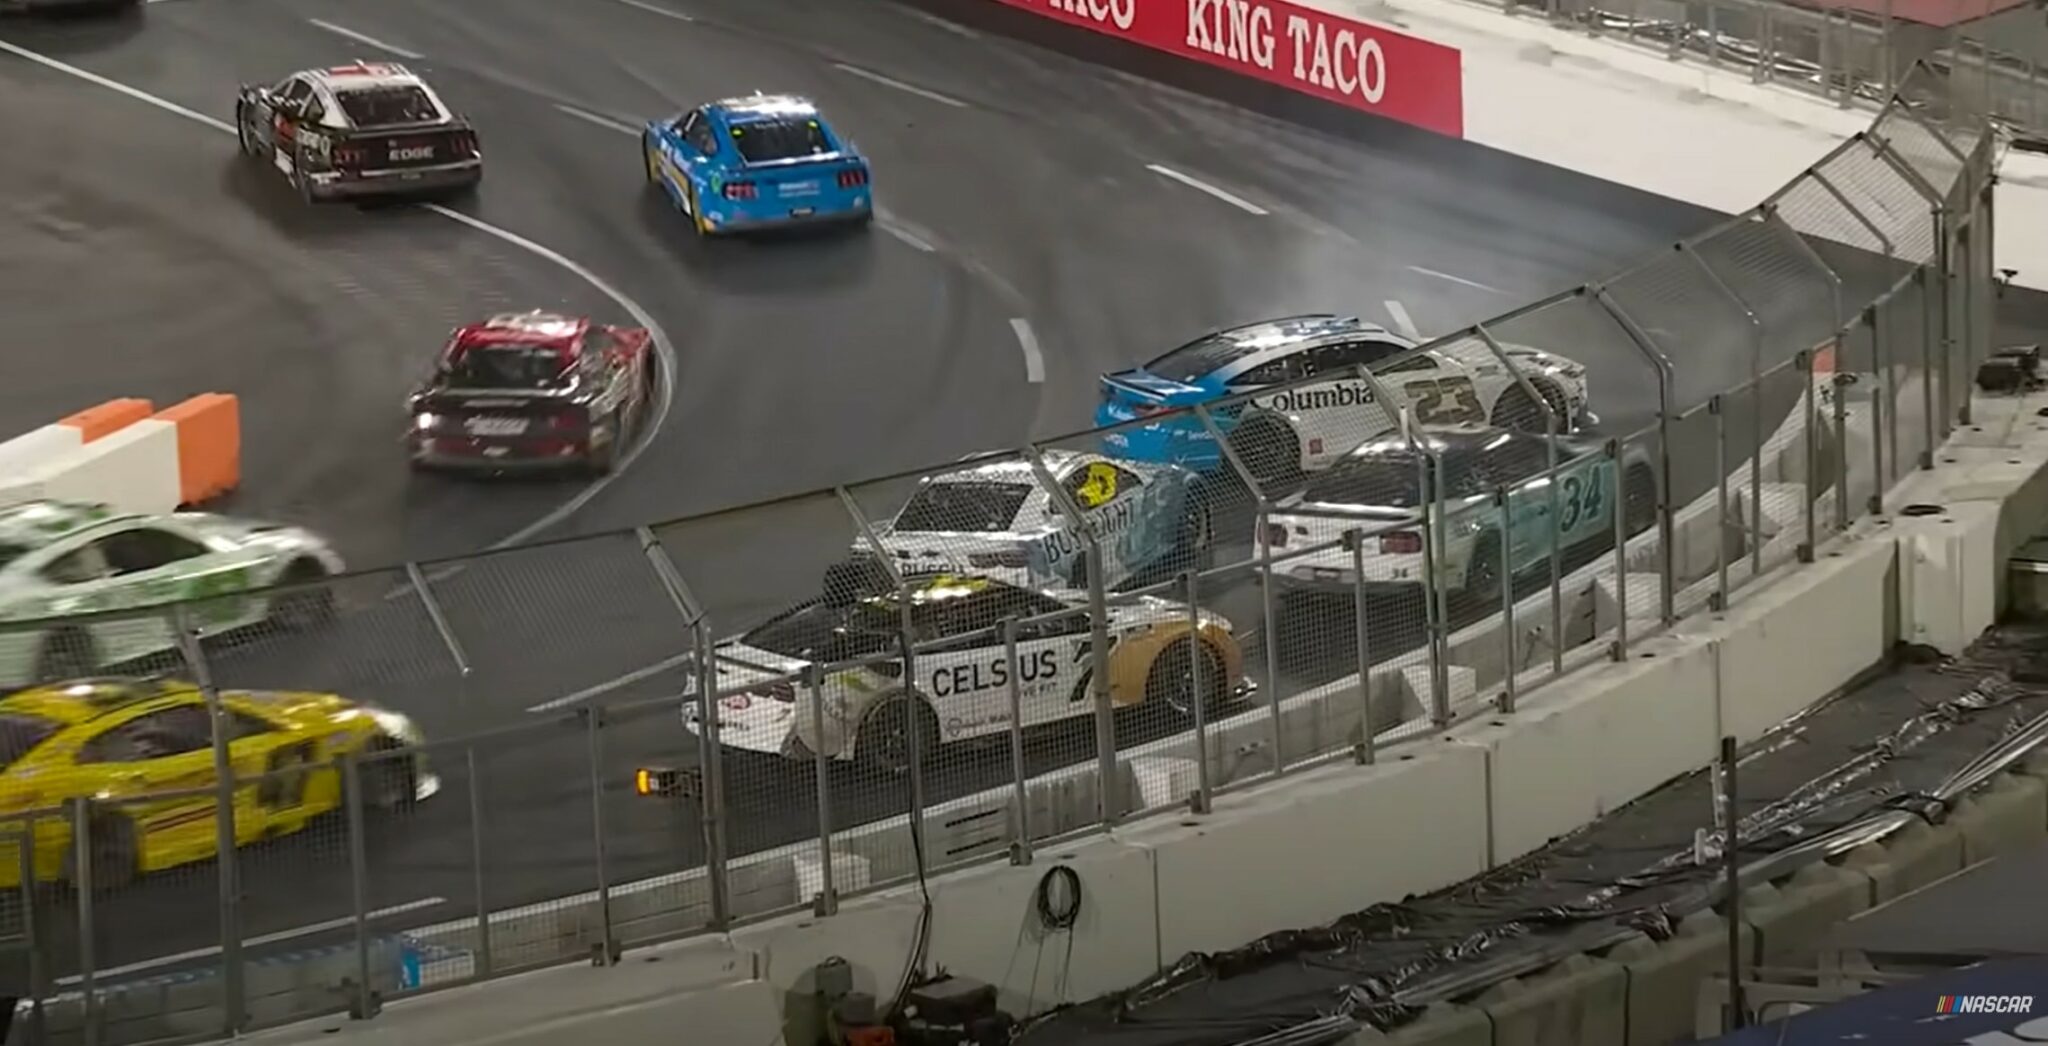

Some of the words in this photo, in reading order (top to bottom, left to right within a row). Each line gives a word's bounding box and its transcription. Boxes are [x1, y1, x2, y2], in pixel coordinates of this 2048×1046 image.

[1187, 0, 1276, 70] KING
[1287, 15, 1386, 104] TACO
[388, 146, 435, 162] EDGE
[1403, 376, 1487, 426] 23
[1561, 465, 1602, 532] 34
[933, 651, 1057, 697] CELSUS
